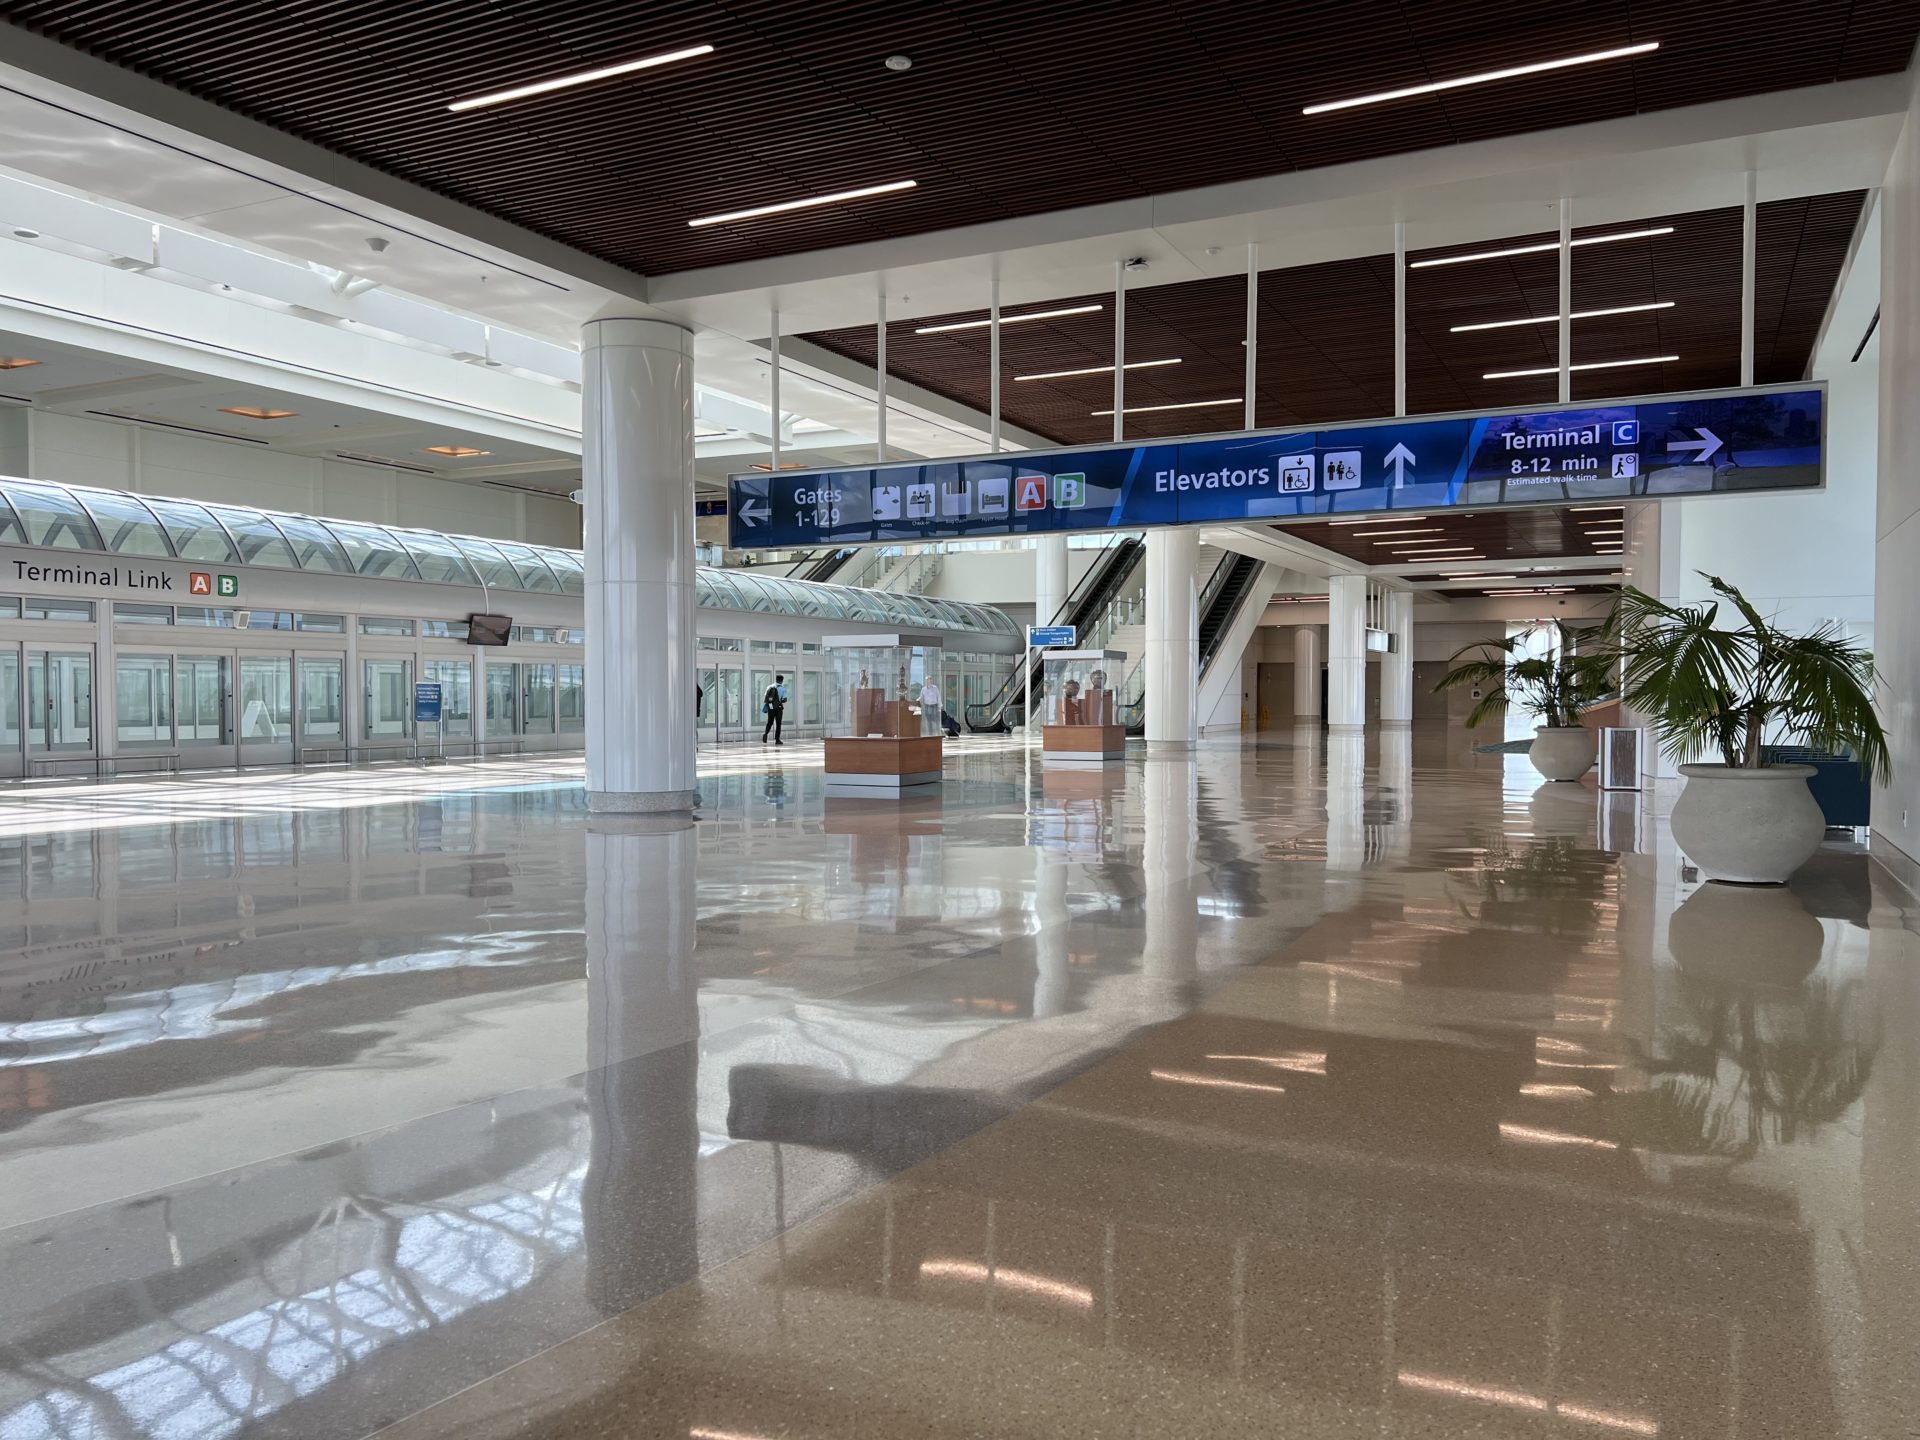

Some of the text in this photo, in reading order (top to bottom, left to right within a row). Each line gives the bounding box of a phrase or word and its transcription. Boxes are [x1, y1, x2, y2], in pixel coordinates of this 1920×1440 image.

[1502, 424, 1633, 450] Terminal C
[1511, 454, 1598, 474] 8-12 min
[1155, 467, 1270, 493] Elevators
[1507, 473, 1598, 486] Estimated walk time
[793, 487, 842, 506] Gates
[1020, 481, 1078, 505] A B
[795, 509, 841, 528] 1-129
[13, 560, 234, 594] Terminal Link A B
